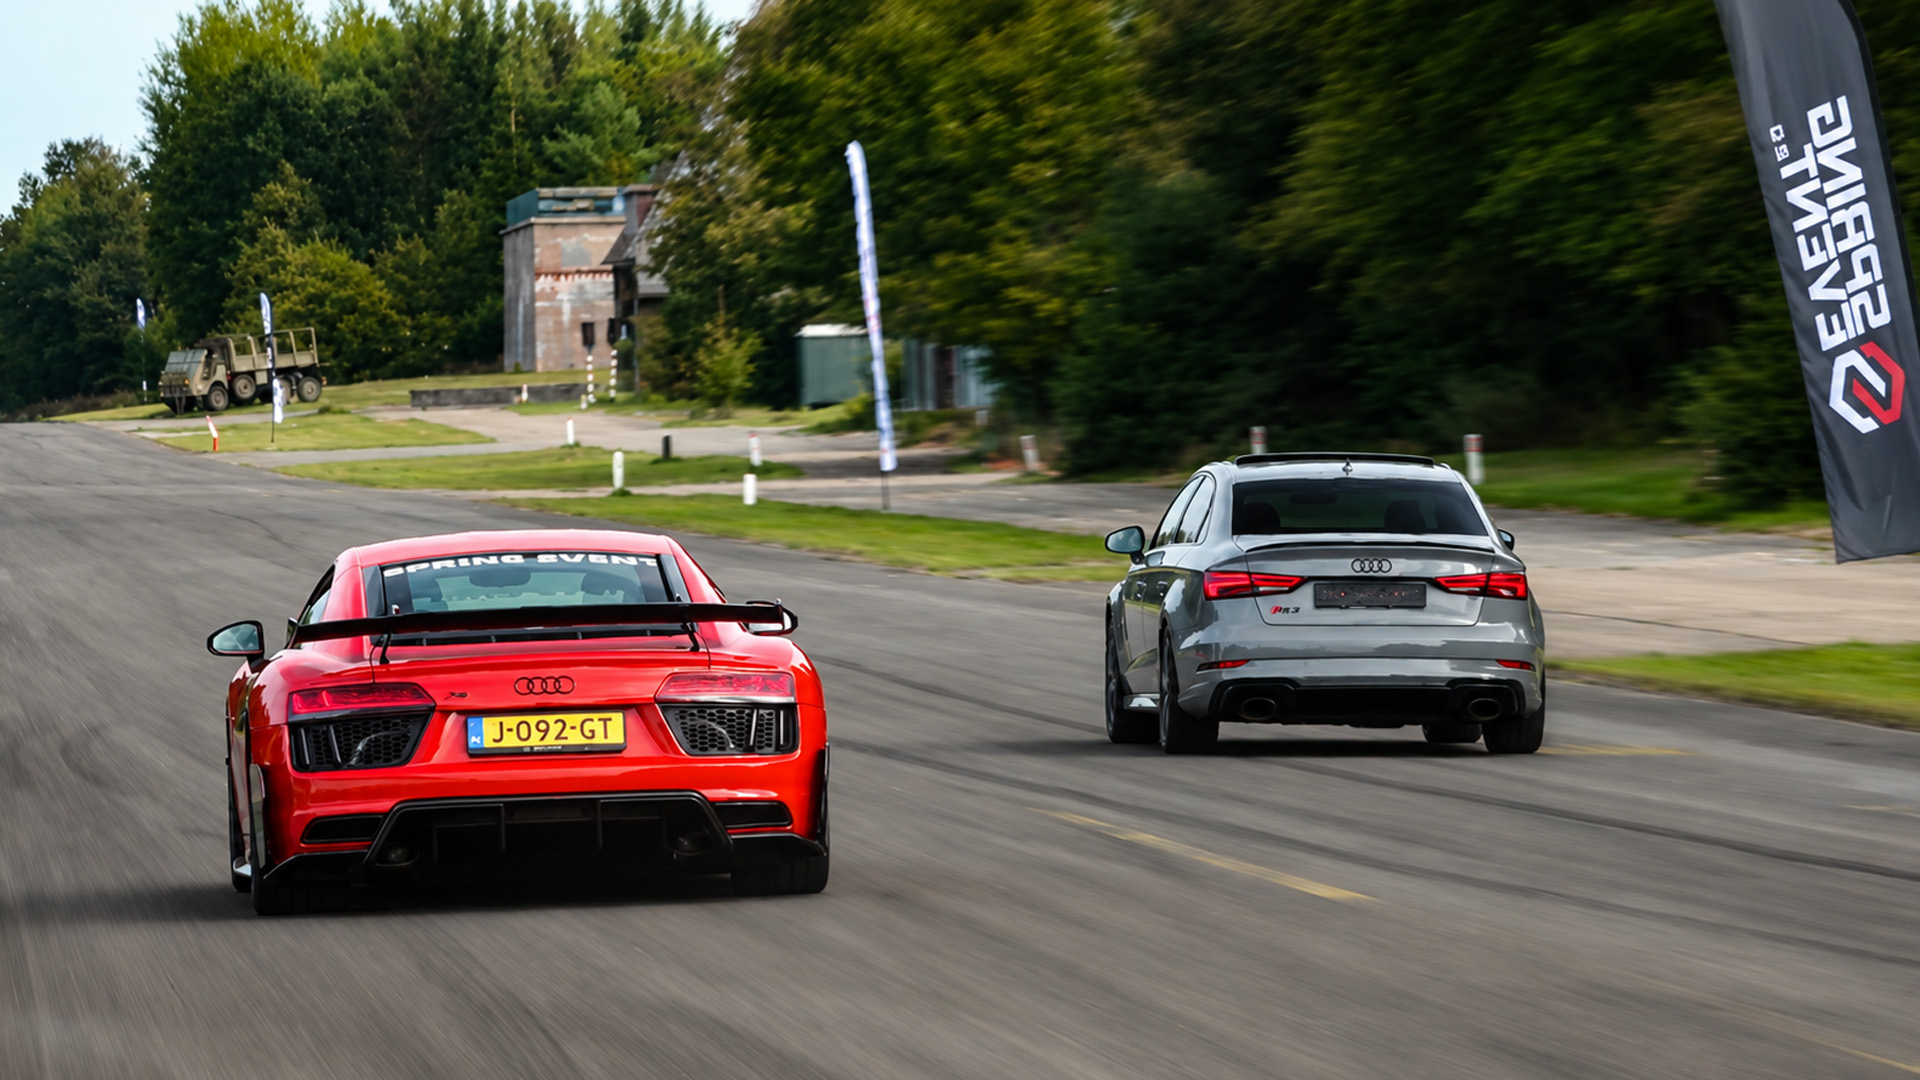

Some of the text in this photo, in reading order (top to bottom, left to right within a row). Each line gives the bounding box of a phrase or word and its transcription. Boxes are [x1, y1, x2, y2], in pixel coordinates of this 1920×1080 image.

[383, 553, 657, 577] SPRING EVENT
[492, 718, 613, 743] J-092-GT
